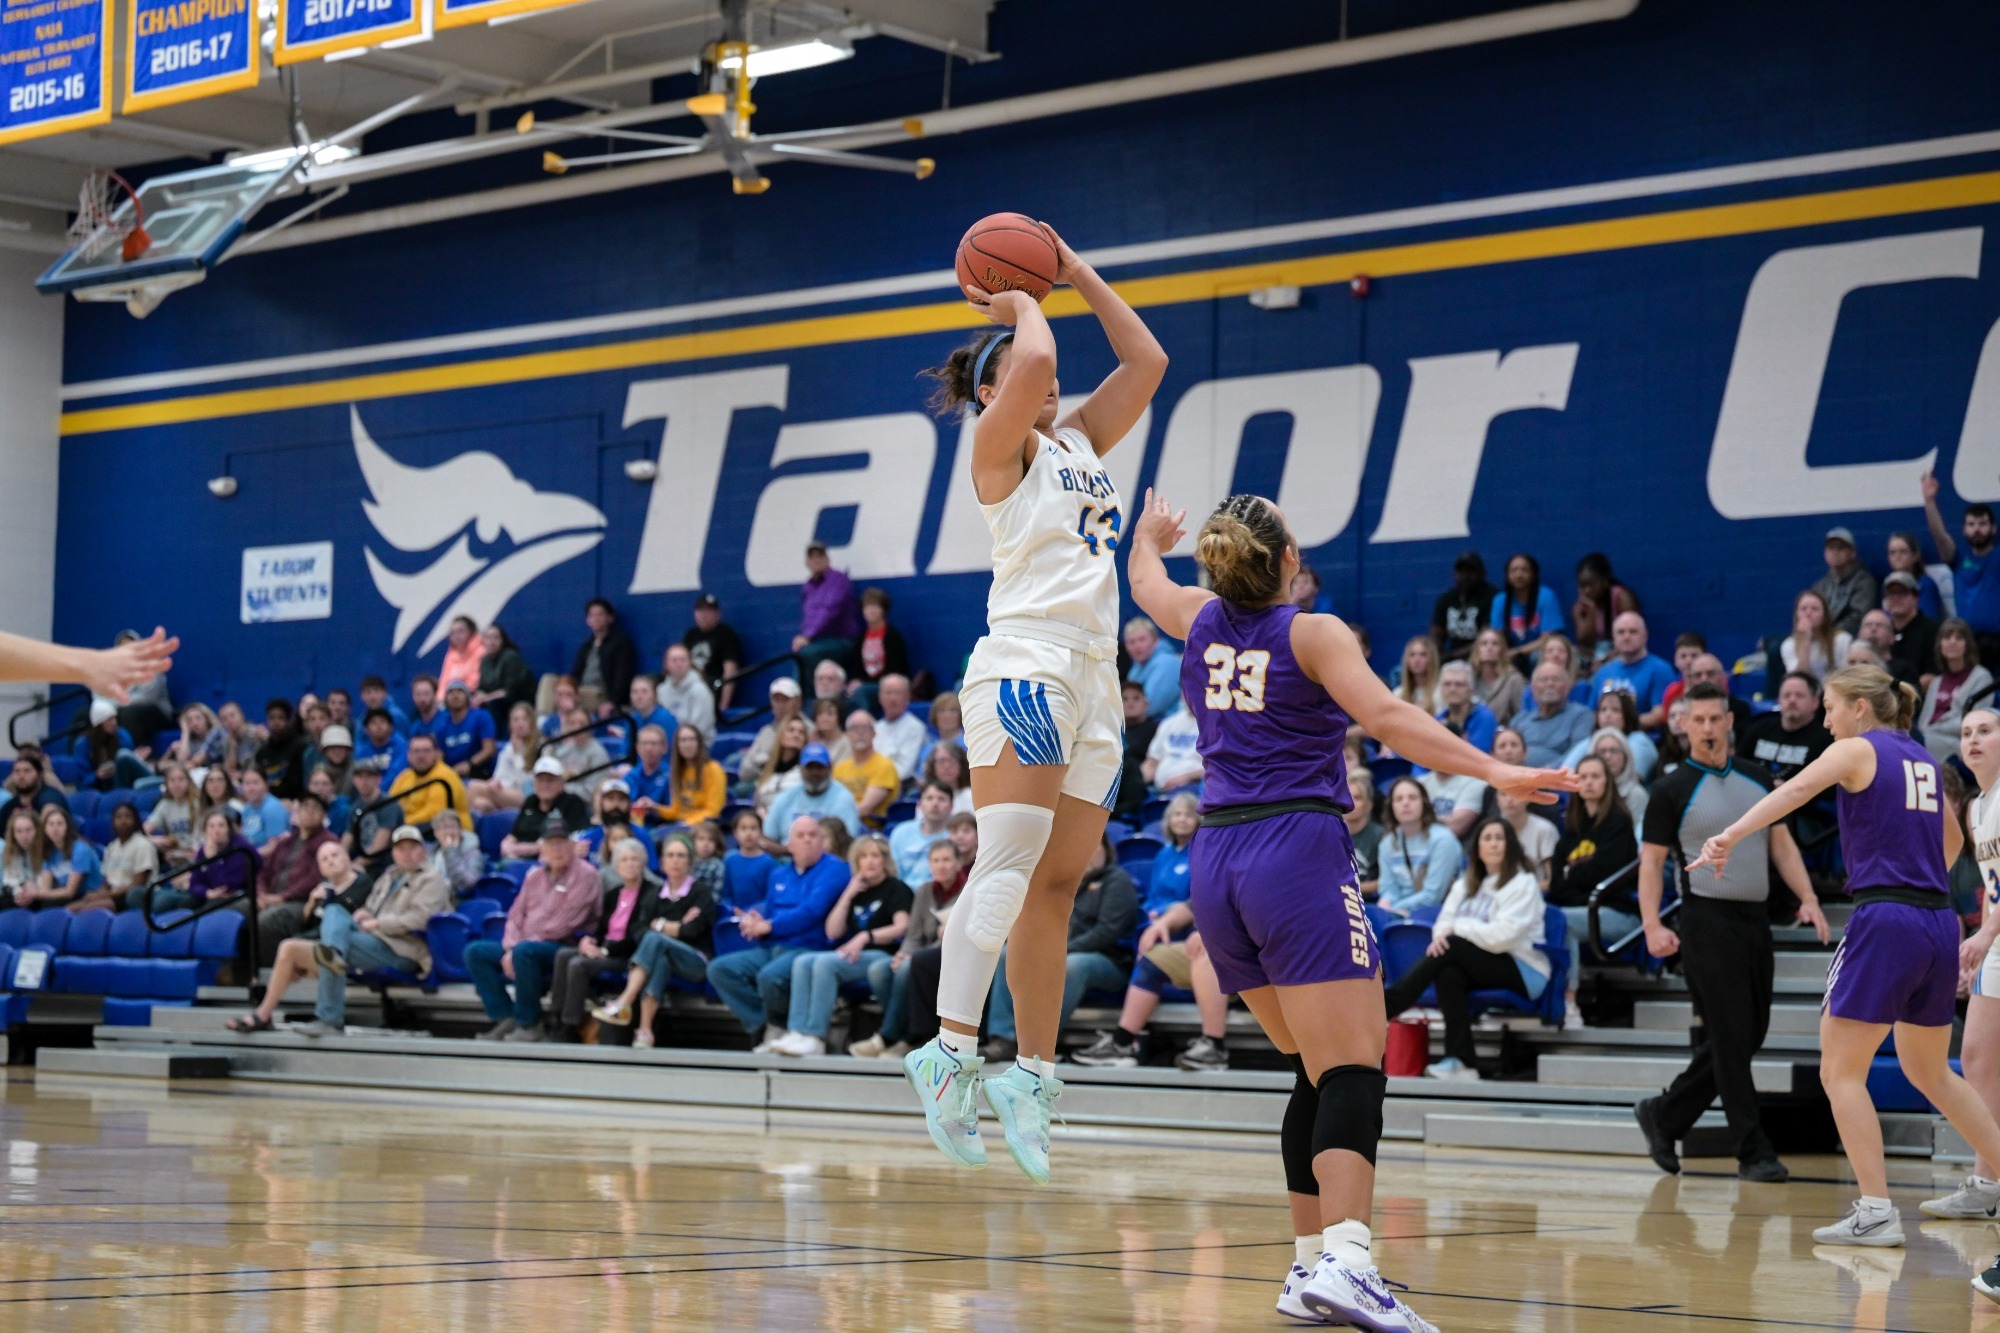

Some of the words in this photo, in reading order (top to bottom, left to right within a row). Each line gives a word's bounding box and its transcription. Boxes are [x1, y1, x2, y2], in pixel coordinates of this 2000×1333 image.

[138, 0, 246, 37] CHAMPION
[150, 31, 233, 75] 2016-17
[9, 72, 85, 113] 2015-16
[1707, 226, 2000, 520] C
[1203, 643, 1270, 712] 33
[1902, 759, 1939, 813] 12
[1340, 884, 1371, 968] YOTES
